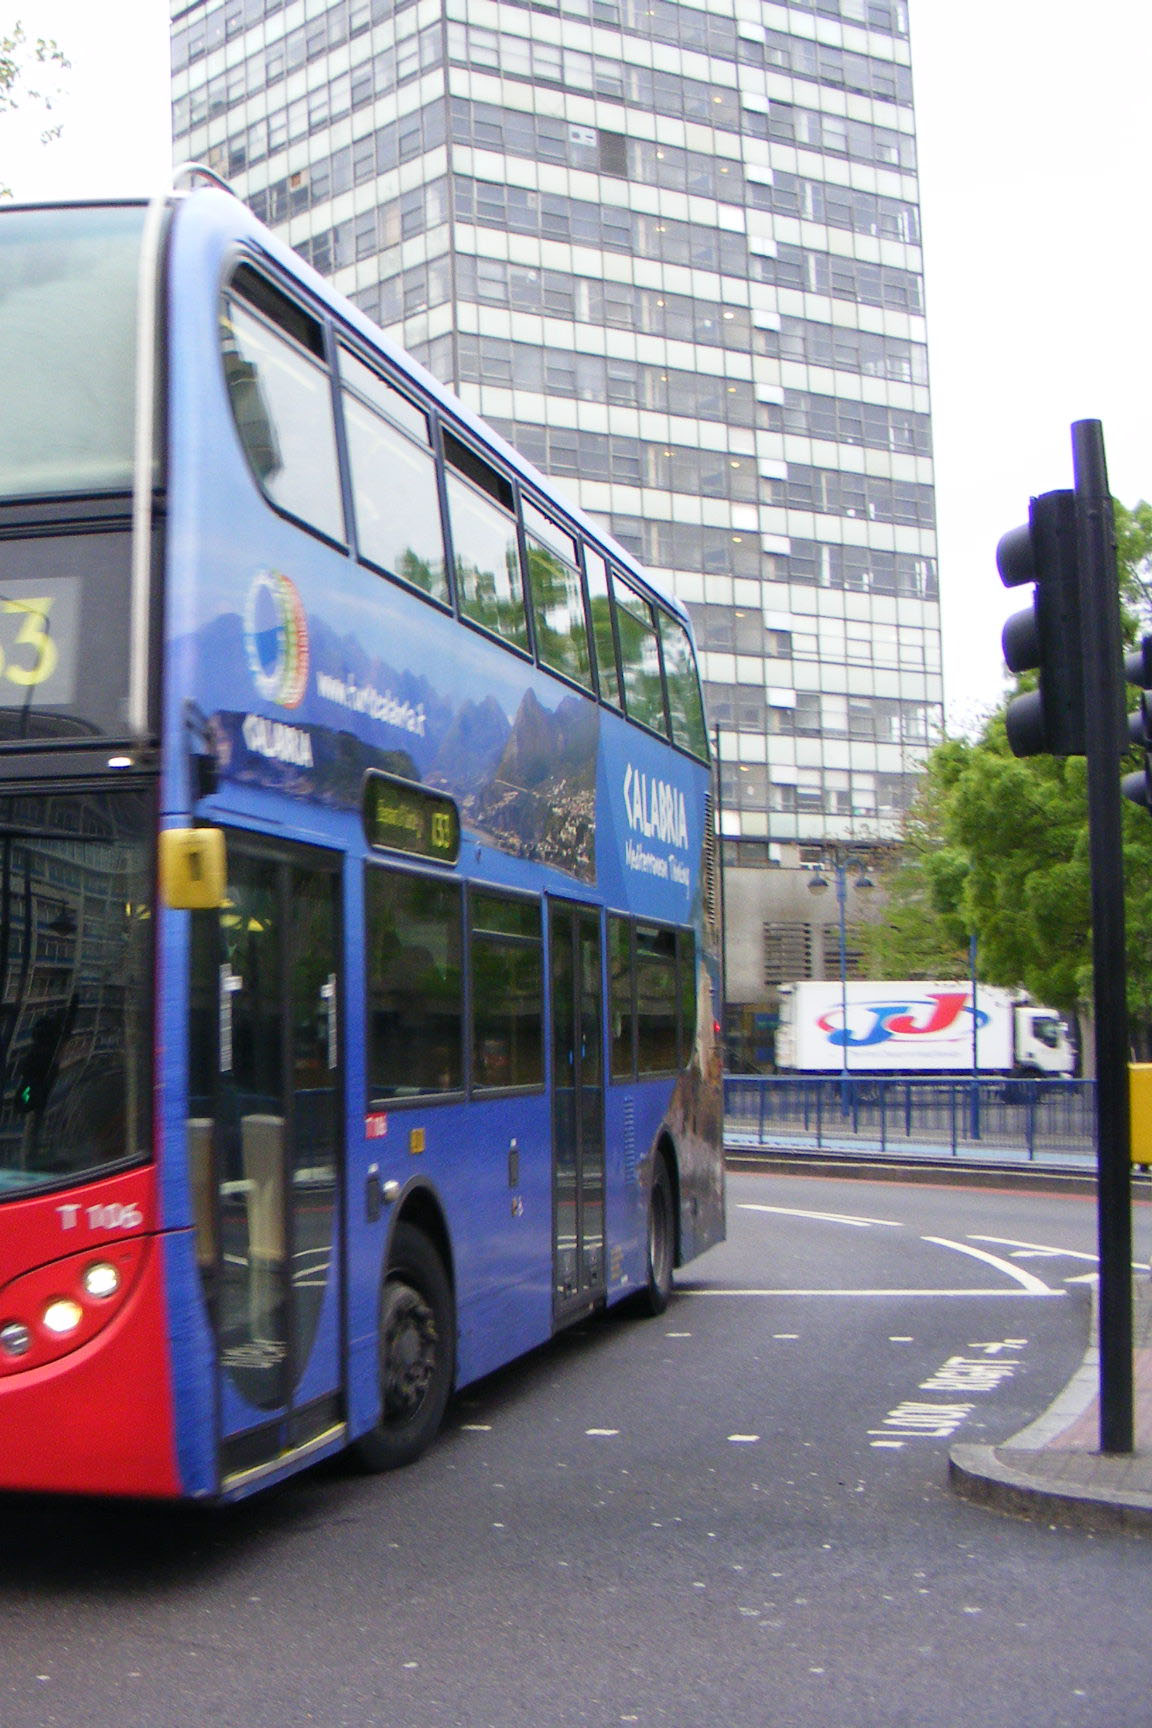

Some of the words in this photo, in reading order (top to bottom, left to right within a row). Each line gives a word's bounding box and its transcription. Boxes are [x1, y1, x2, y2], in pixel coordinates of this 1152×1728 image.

[624, 762, 688, 851] CALABRIA
[56, 1203, 82, 1231] T
[86, 1203, 143, 1230] 106
[866, 1401, 976, 1437] LOOK
